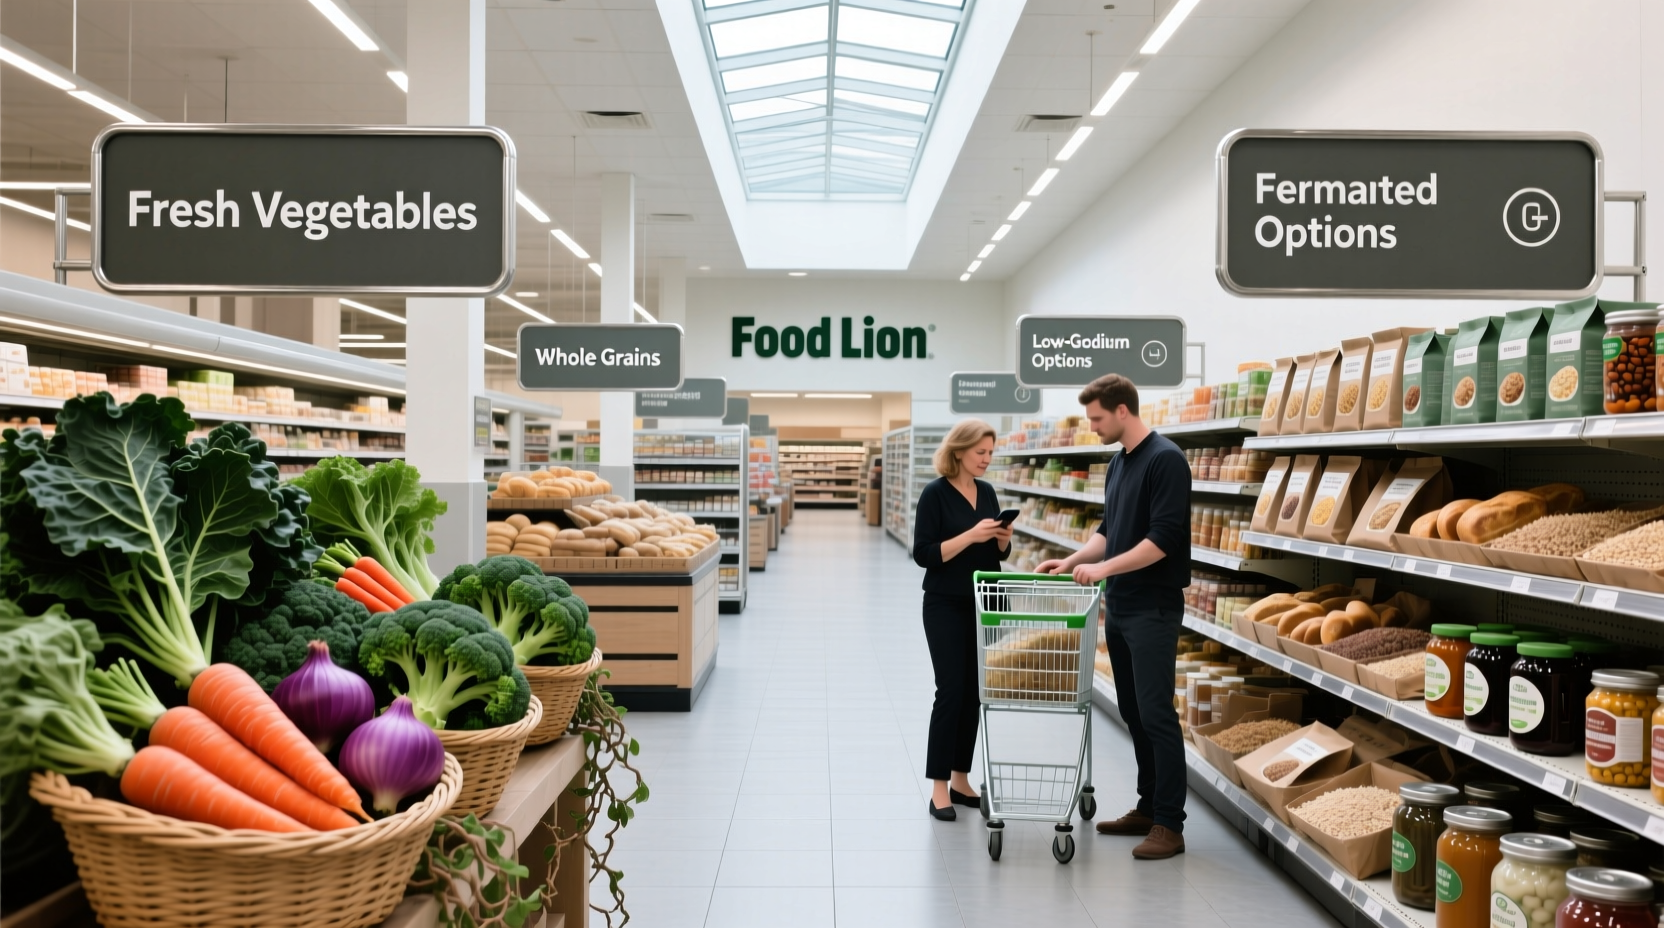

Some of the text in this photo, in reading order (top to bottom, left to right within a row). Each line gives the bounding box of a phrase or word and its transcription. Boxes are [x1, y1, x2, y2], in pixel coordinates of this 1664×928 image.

[128, 188, 478, 241] Fresh Vegetables
[1254, 214, 1397, 257] Options
[731, 315, 927, 359] Food Lion
[1032, 333, 1130, 350] Low-Godium
[534, 347, 661, 367] Whole Grains
[1031, 352, 1093, 372] Options
